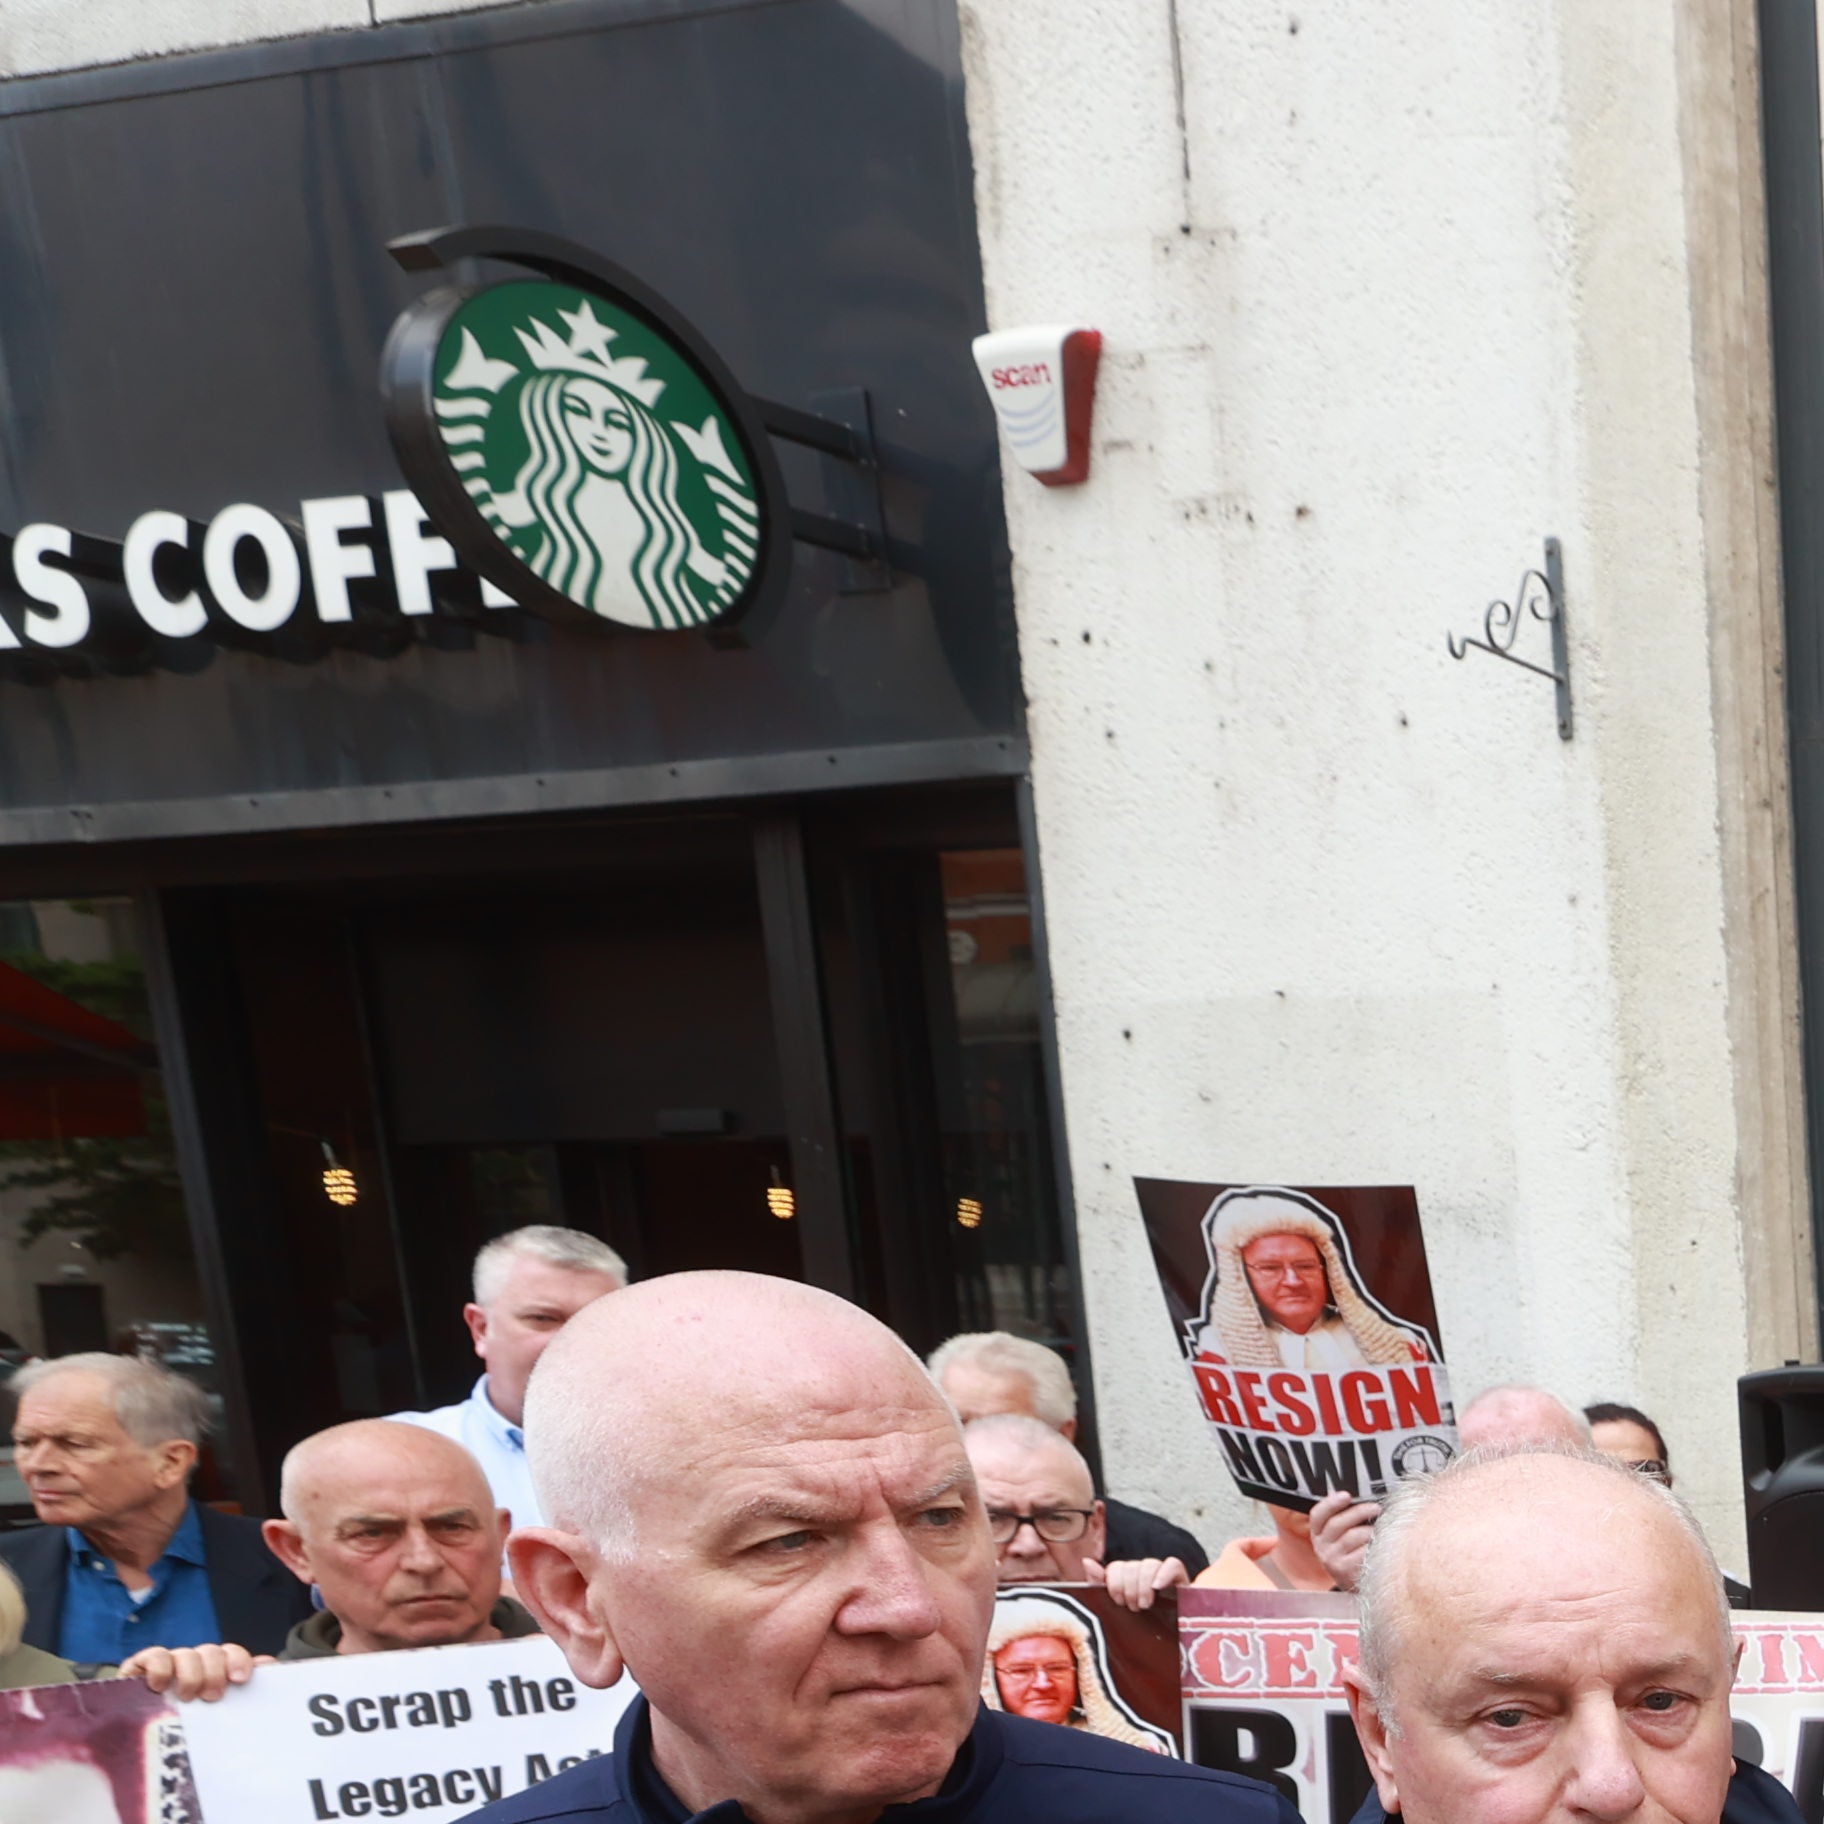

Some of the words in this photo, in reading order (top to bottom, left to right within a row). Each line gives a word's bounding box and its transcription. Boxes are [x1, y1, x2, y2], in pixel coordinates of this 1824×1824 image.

[991, 364, 1051, 390] scan
[0, 523, 90, 648] S
[123, 490, 520, 637] COFF
[1192, 1366, 1442, 1436] RESIGN
[1217, 1427, 1388, 1498] NOW!
[308, 1683, 472, 1736] Scrap
[489, 1675, 577, 1717] the
[308, 1763, 503, 1822] Legacy
